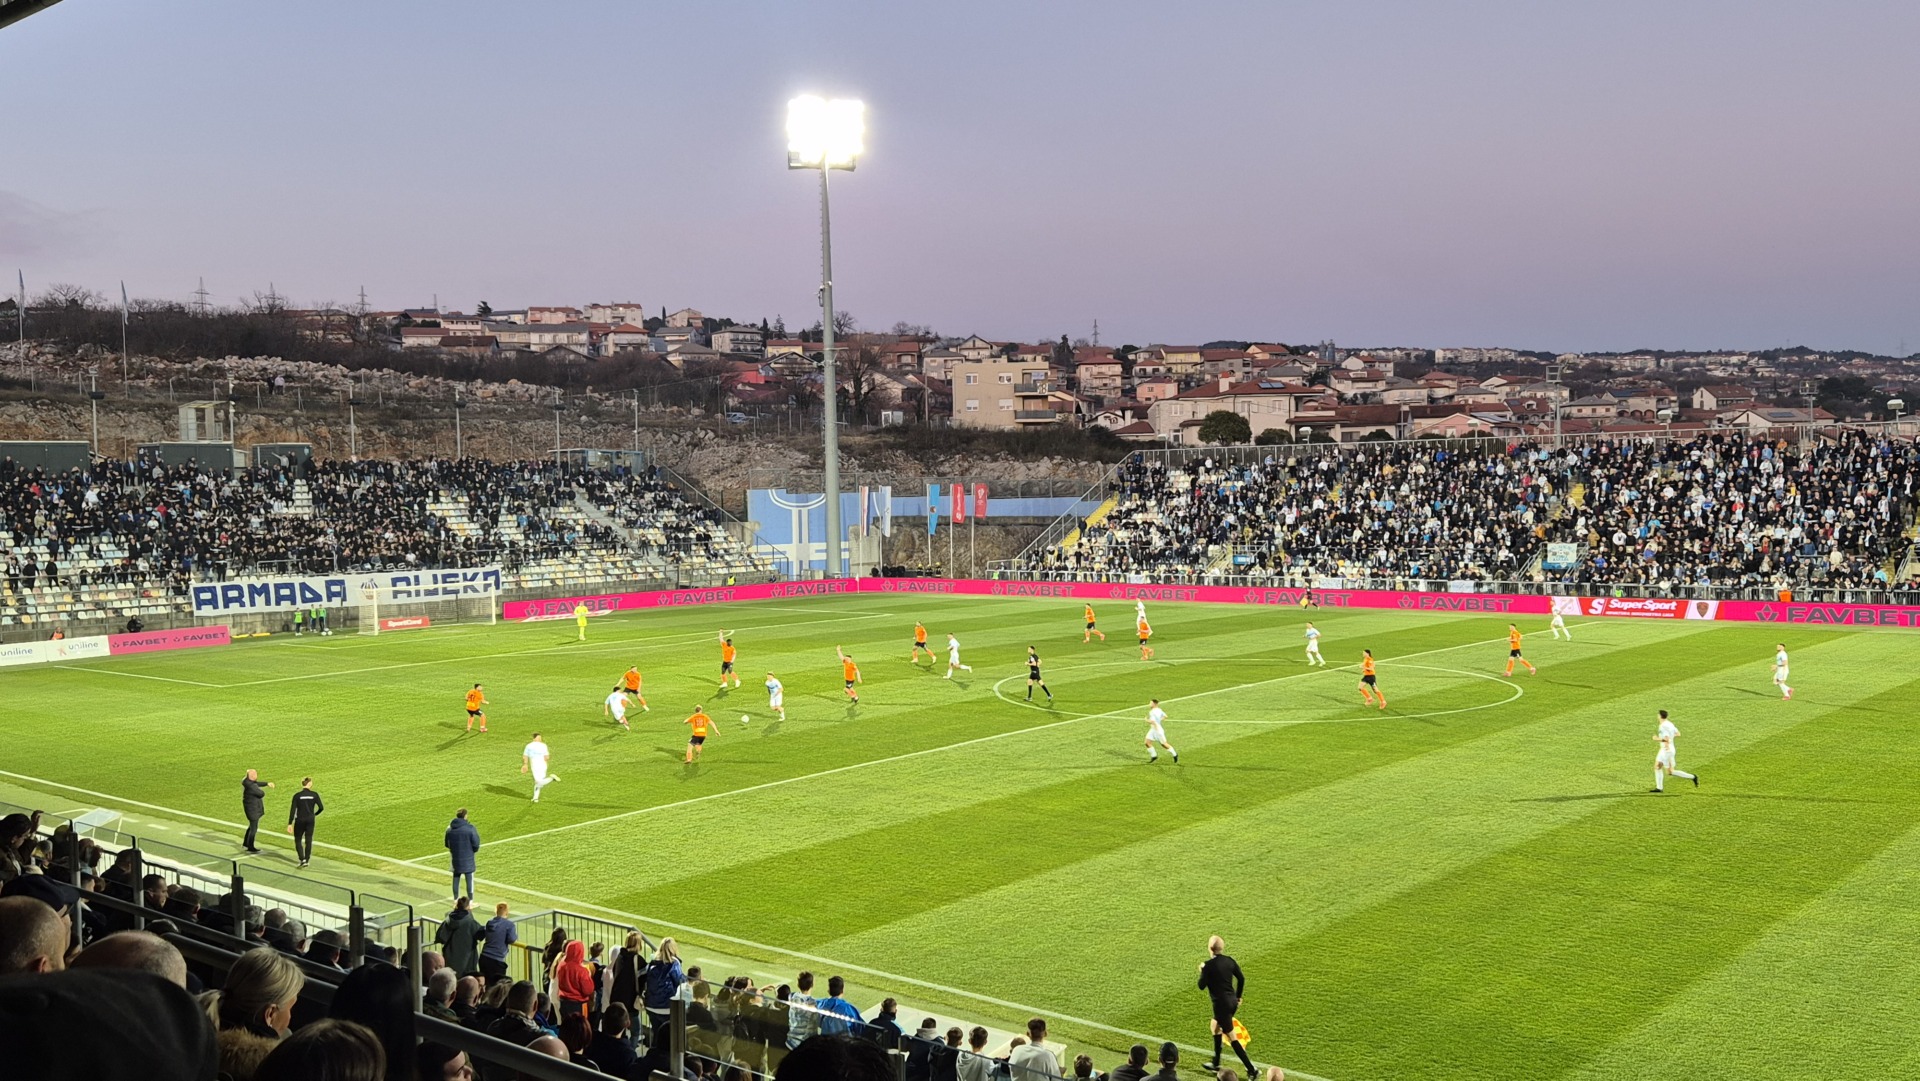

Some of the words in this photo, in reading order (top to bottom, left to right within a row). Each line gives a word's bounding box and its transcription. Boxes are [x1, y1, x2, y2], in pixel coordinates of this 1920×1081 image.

[786, 582, 848, 596] FAVBET
[897, 581, 956, 592] FAVBET
[1007, 584, 1075, 597] FAVBET
[1126, 587, 1198, 600] FAVBET
[193, 579, 347, 611] ARMADA
[673, 590, 736, 604] FAVBET
[1419, 596, 1514, 612] FAVBET
[1608, 598, 1678, 611] SuperSport
[1787, 607, 1920, 627] FAVBET
[122, 637, 167, 647] FAVBET
[183, 632, 226, 642] FAVBET
[0, 648, 33, 656] uniline
[68, 641, 99, 650] uniline
